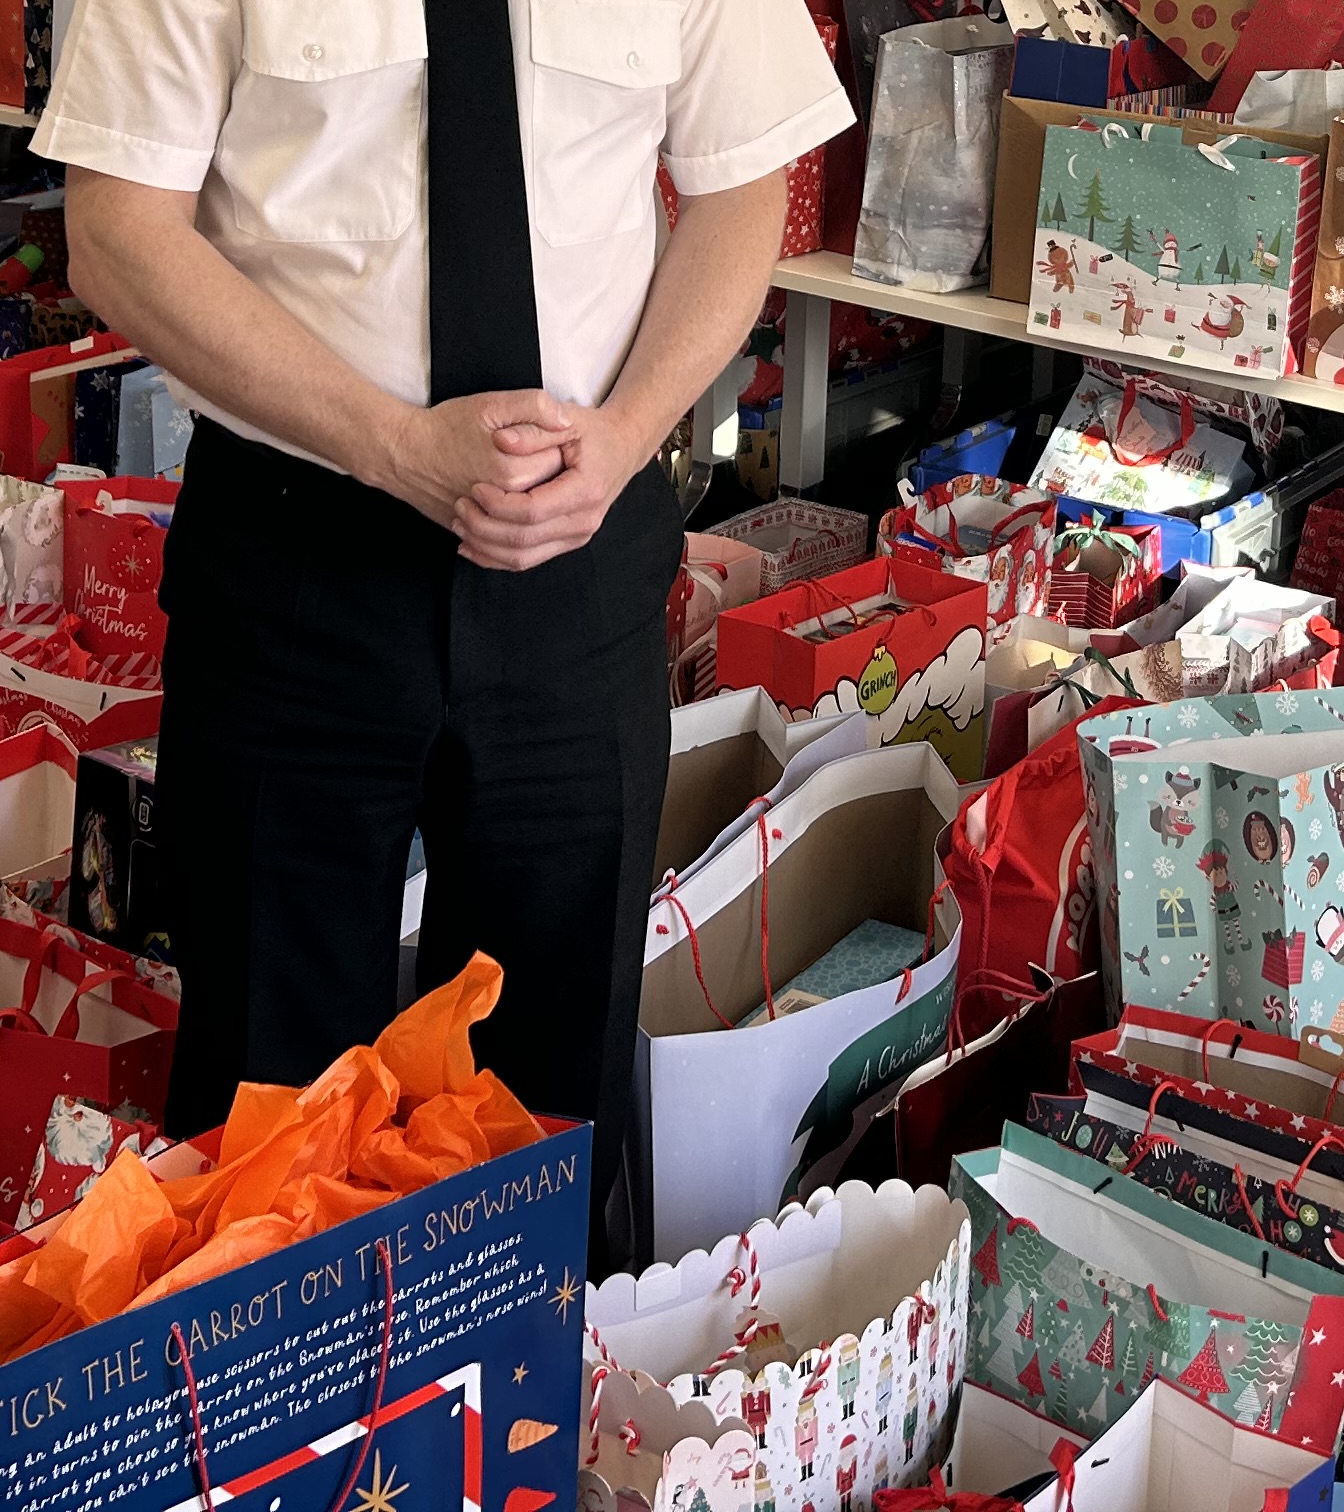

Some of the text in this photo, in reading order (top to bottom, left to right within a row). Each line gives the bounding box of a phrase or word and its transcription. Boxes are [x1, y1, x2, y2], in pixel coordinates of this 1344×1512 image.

[84, 563, 129, 610] Merry
[861, 670, 896, 700] GRINCH
[856, 1058, 870, 1095] A
[6, 1481, 23, 1502] it
[28, 1471, 47, 1489] in
[52, 1451, 99, 1480] turns
[102, 1439, 119, 1458] to
[126, 1425, 151, 1449] pin
[156, 1409, 182, 1433] the
[246, 1373, 265, 1393] on
[268, 1360, 293, 1382] the
[299, 1324, 374, 1365] Snowman's
[415, 1273, 482, 1314] Remember
[484, 1254, 520, 1279] which
[20, 1479, 80, 1512] carrot
[85, 1468, 111, 1494] you
[117, 1449, 160, 1476] chose
[163, 1437, 179, 1452] so
[213, 1405, 250, 1431] know
[254, 1380, 296, 1412] where
[301, 1359, 345, 1392] you've
[398, 1329, 415, 1346] it.
[418, 1312, 440, 1333] Use
[444, 1301, 467, 1324] the
[470, 1282, 515, 1315] glasses
[518, 1273, 533, 1289] as
[536, 1263, 545, 1276] a
[24, 1451, 47, 1469] an
[53, 1422, 98, 1455] adult
[102, 1412, 121, 1431] to
[163, 1384, 190, 1412] you
[197, 1371, 221, 1393] use
[224, 1339, 281, 1379] scissors
[284, 1329, 300, 1350] to
[306, 1319, 331, 1341] cut
[333, 1308, 357, 1330] out
[362, 1296, 386, 1318] the
[390, 1269, 445, 1306] carrots
[448, 1251, 475, 1277] and
[477, 1233, 524, 1265] glasses.
[82, 1339, 149, 1402] THE
[164, 1280, 288, 1368] CARROT
[300, 1258, 344, 1308] ON
[356, 1224, 412, 1281] THE
[423, 1154, 577, 1252] SNOWMAN
[109, 1473, 150, 1501] can't
[154, 1459, 178, 1482] see
[214, 1414, 283, 1454] snowman.
[286, 1394, 312, 1418] The
[317, 1374, 367, 1405] closest
[389, 1348, 413, 1372] the
[416, 1315, 483, 1359] snowman's
[485, 1302, 514, 1321] nose
[516, 1279, 549, 1309] wins!
